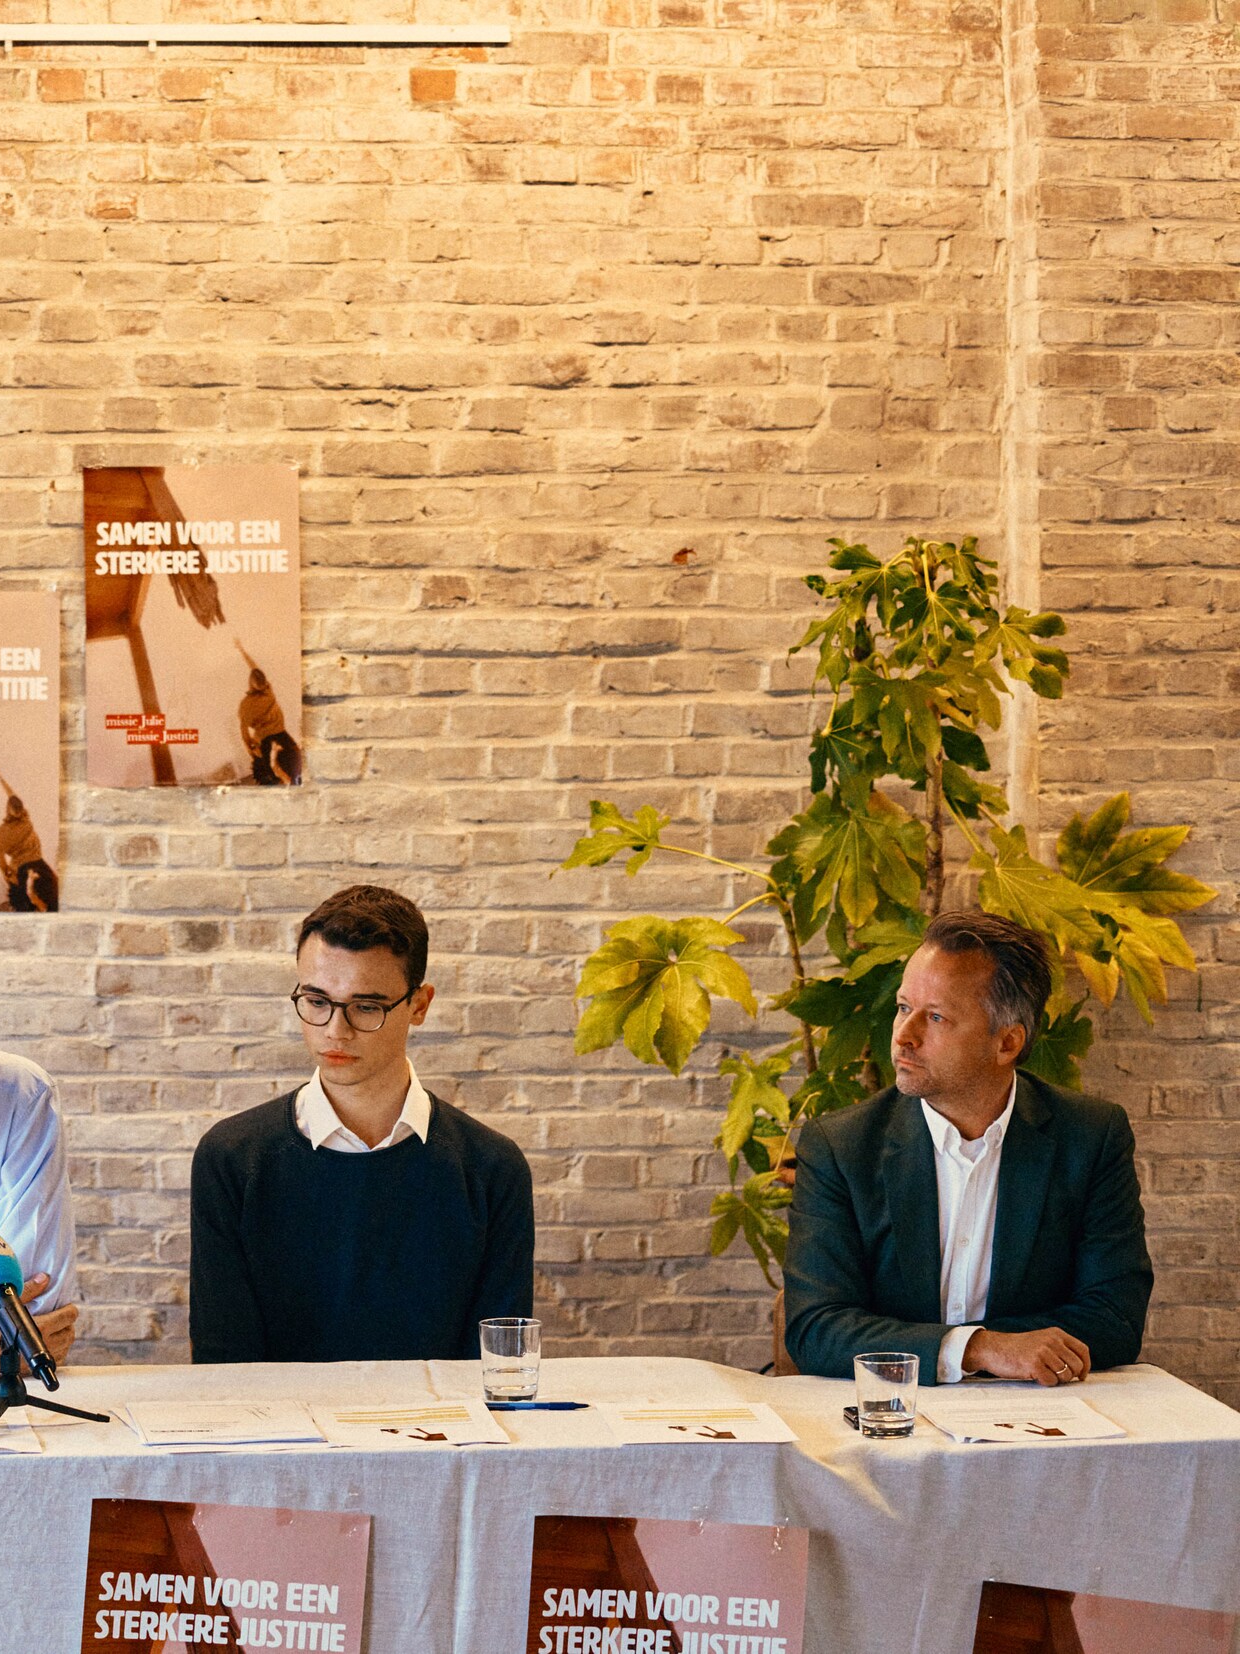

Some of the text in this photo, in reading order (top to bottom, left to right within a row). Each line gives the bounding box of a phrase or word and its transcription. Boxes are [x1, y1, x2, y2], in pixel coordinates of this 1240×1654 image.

[96, 520, 281, 546] SAMEN VOOR EEN
[95, 549, 289, 575] STERKERE JUSTITIE
[0, 647, 41, 671] EEN
[106, 715, 165, 729] missie Julie
[127, 730, 198, 744] missie Justitie
[98, 1571, 339, 1615] SAMEN VOOR EEN
[542, 1587, 780, 1628] SAMEN VOOR EEN
[94, 1609, 346, 1653] STERKERE JUSTITIE
[538, 1625, 672, 1654] STERKERE
